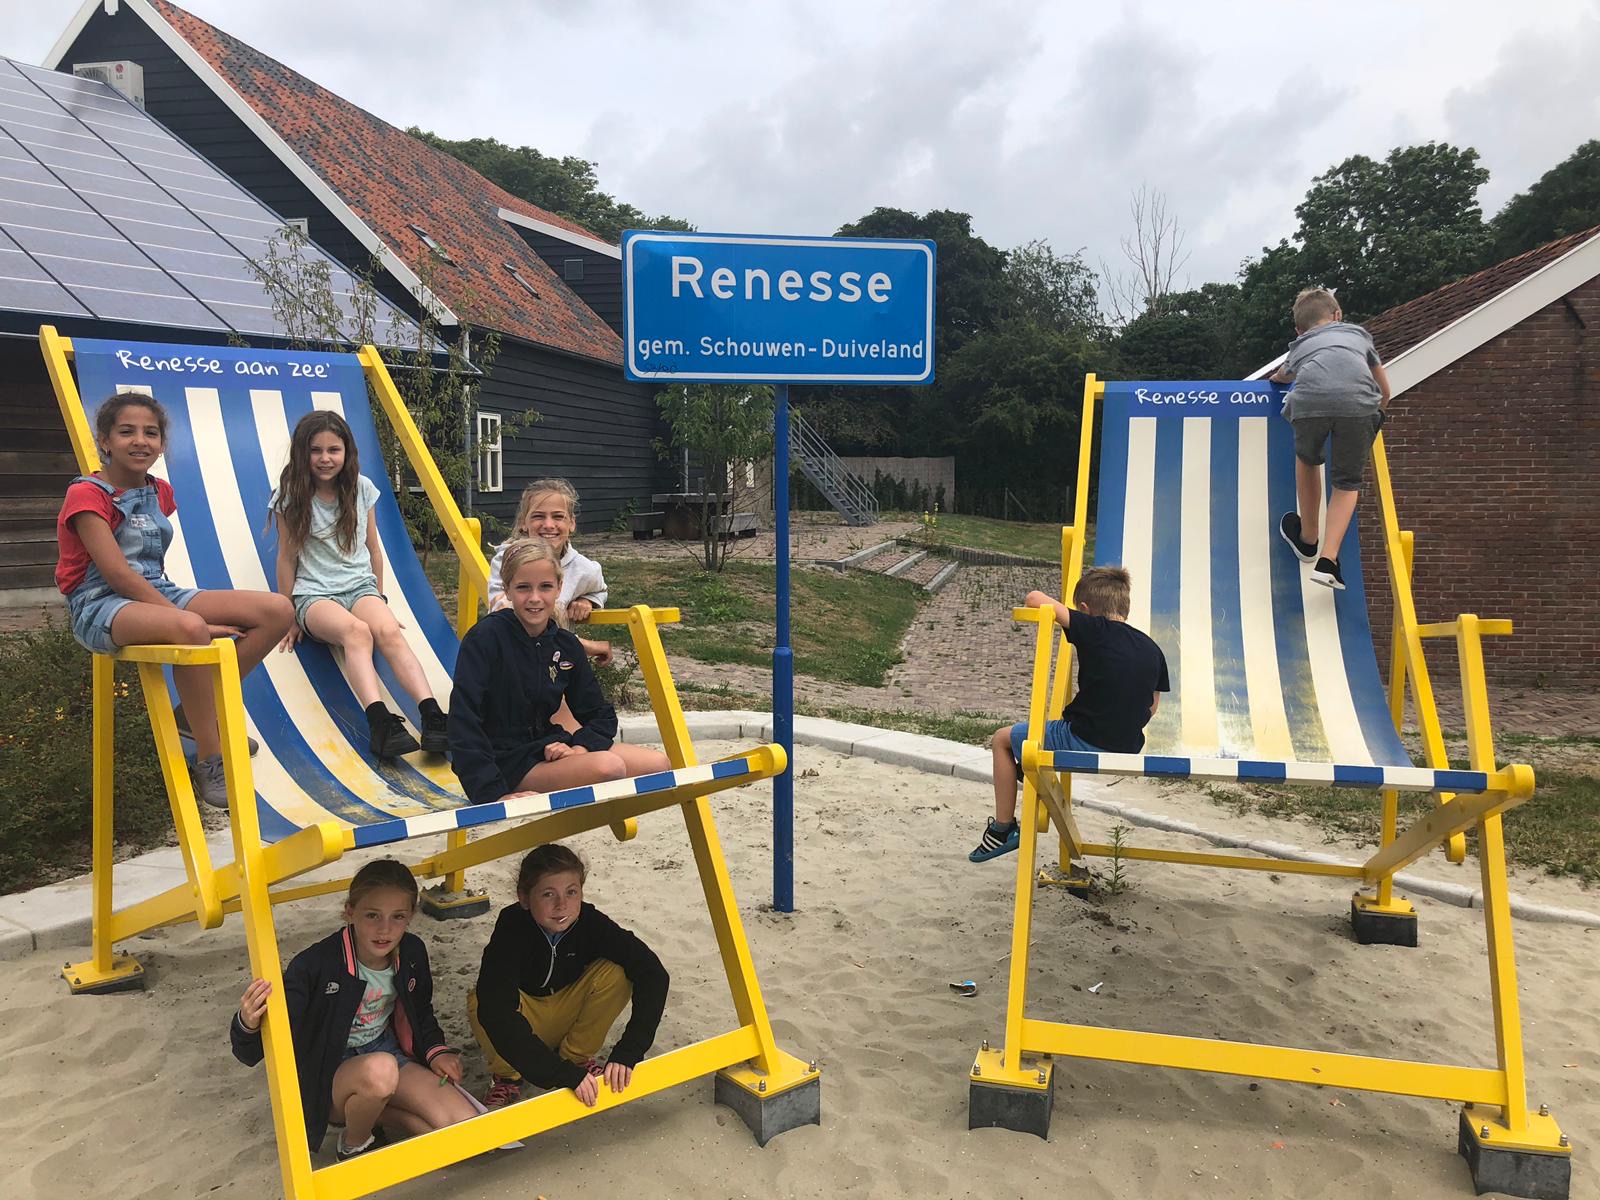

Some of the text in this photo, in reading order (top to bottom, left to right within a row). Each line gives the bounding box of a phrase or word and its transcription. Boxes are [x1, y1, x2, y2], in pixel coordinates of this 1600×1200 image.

[671, 256, 892, 303] Renesse
[638, 336, 924, 360] gem. Schouwen-Duiveland
[234, 361, 279, 376] aan
[1230, 390, 1269, 404] aan
